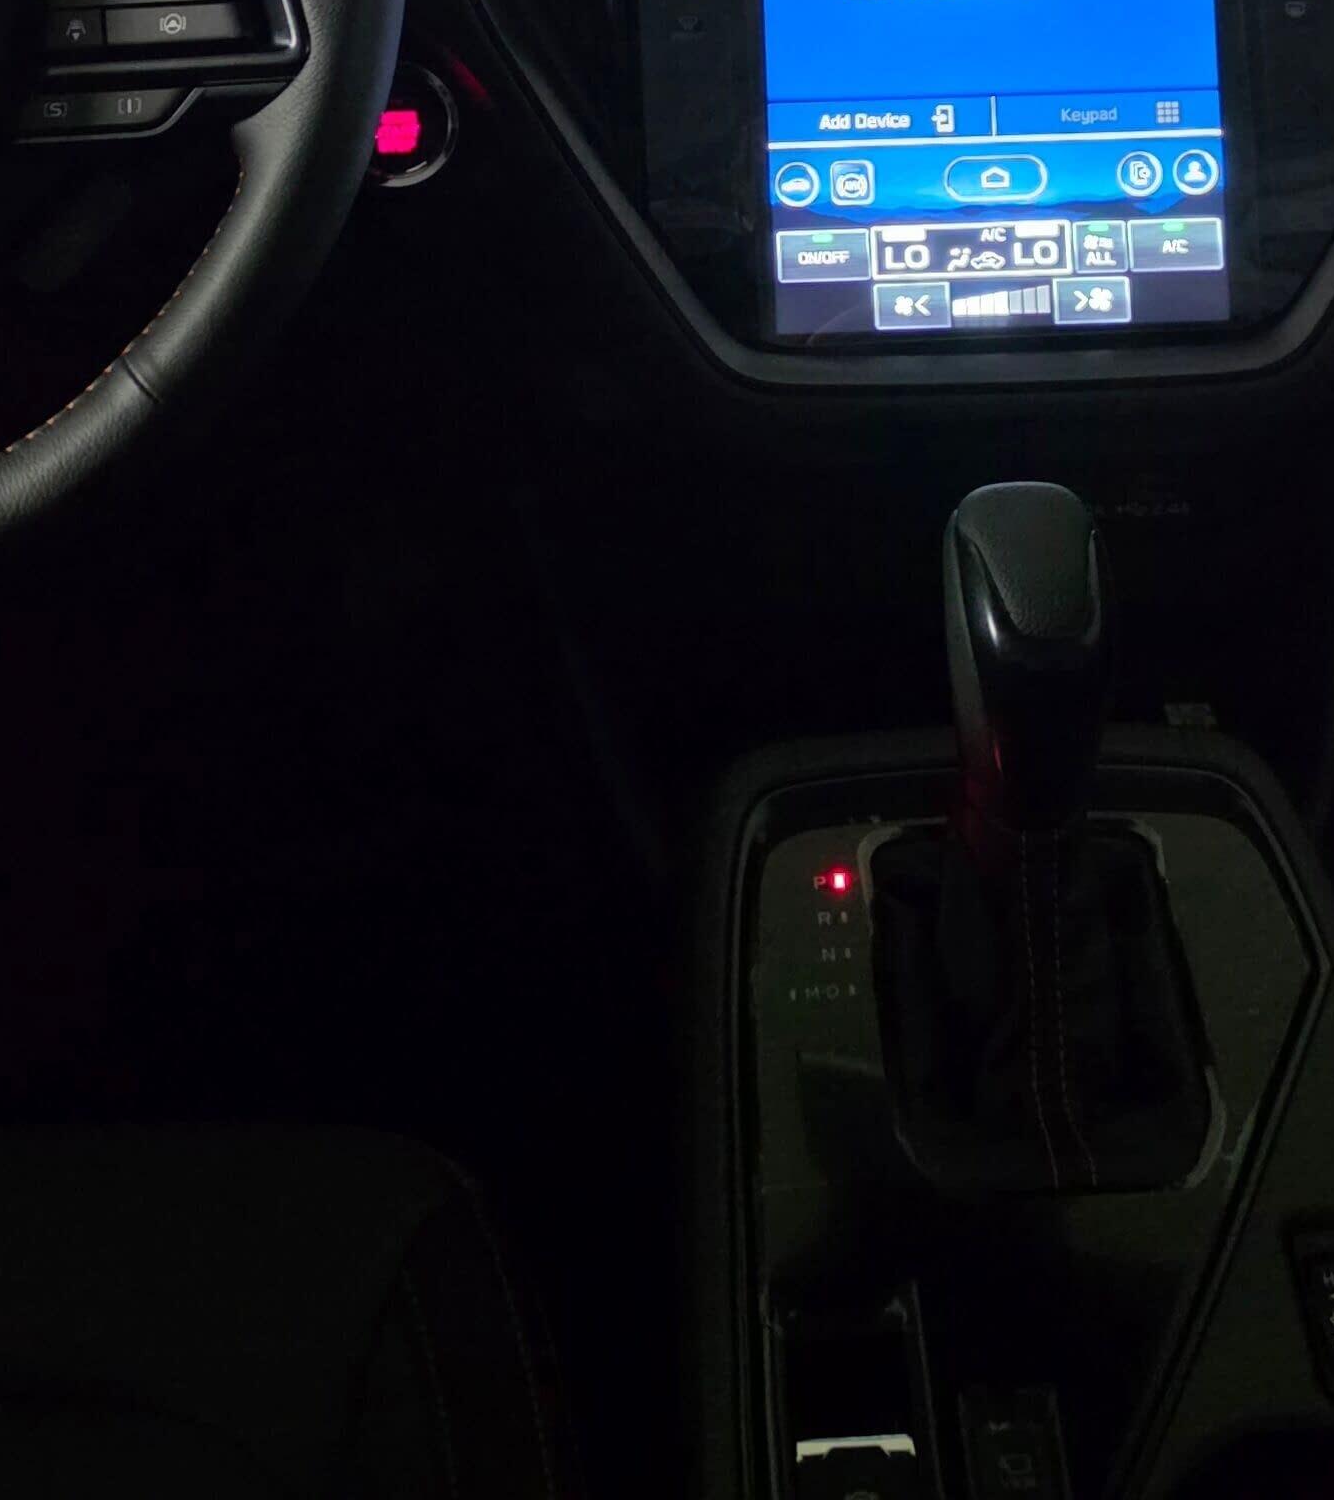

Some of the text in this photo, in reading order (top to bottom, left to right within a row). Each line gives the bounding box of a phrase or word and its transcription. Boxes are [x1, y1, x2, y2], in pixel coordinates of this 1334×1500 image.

[819, 112, 911, 131] Add Device
[1060, 106, 1118, 125] Keypad
[980, 227, 1007, 243] A/C
[1013, 240, 1060, 266] LO
[1162, 238, 1189, 254] A/C
[798, 250, 851, 265] ON/OFF
[884, 244, 931, 271] LO
[1085, 251, 1117, 267] ALL
[814, 876, 827, 890] P
[818, 911, 831, 925] R
[822, 949, 836, 961] N
